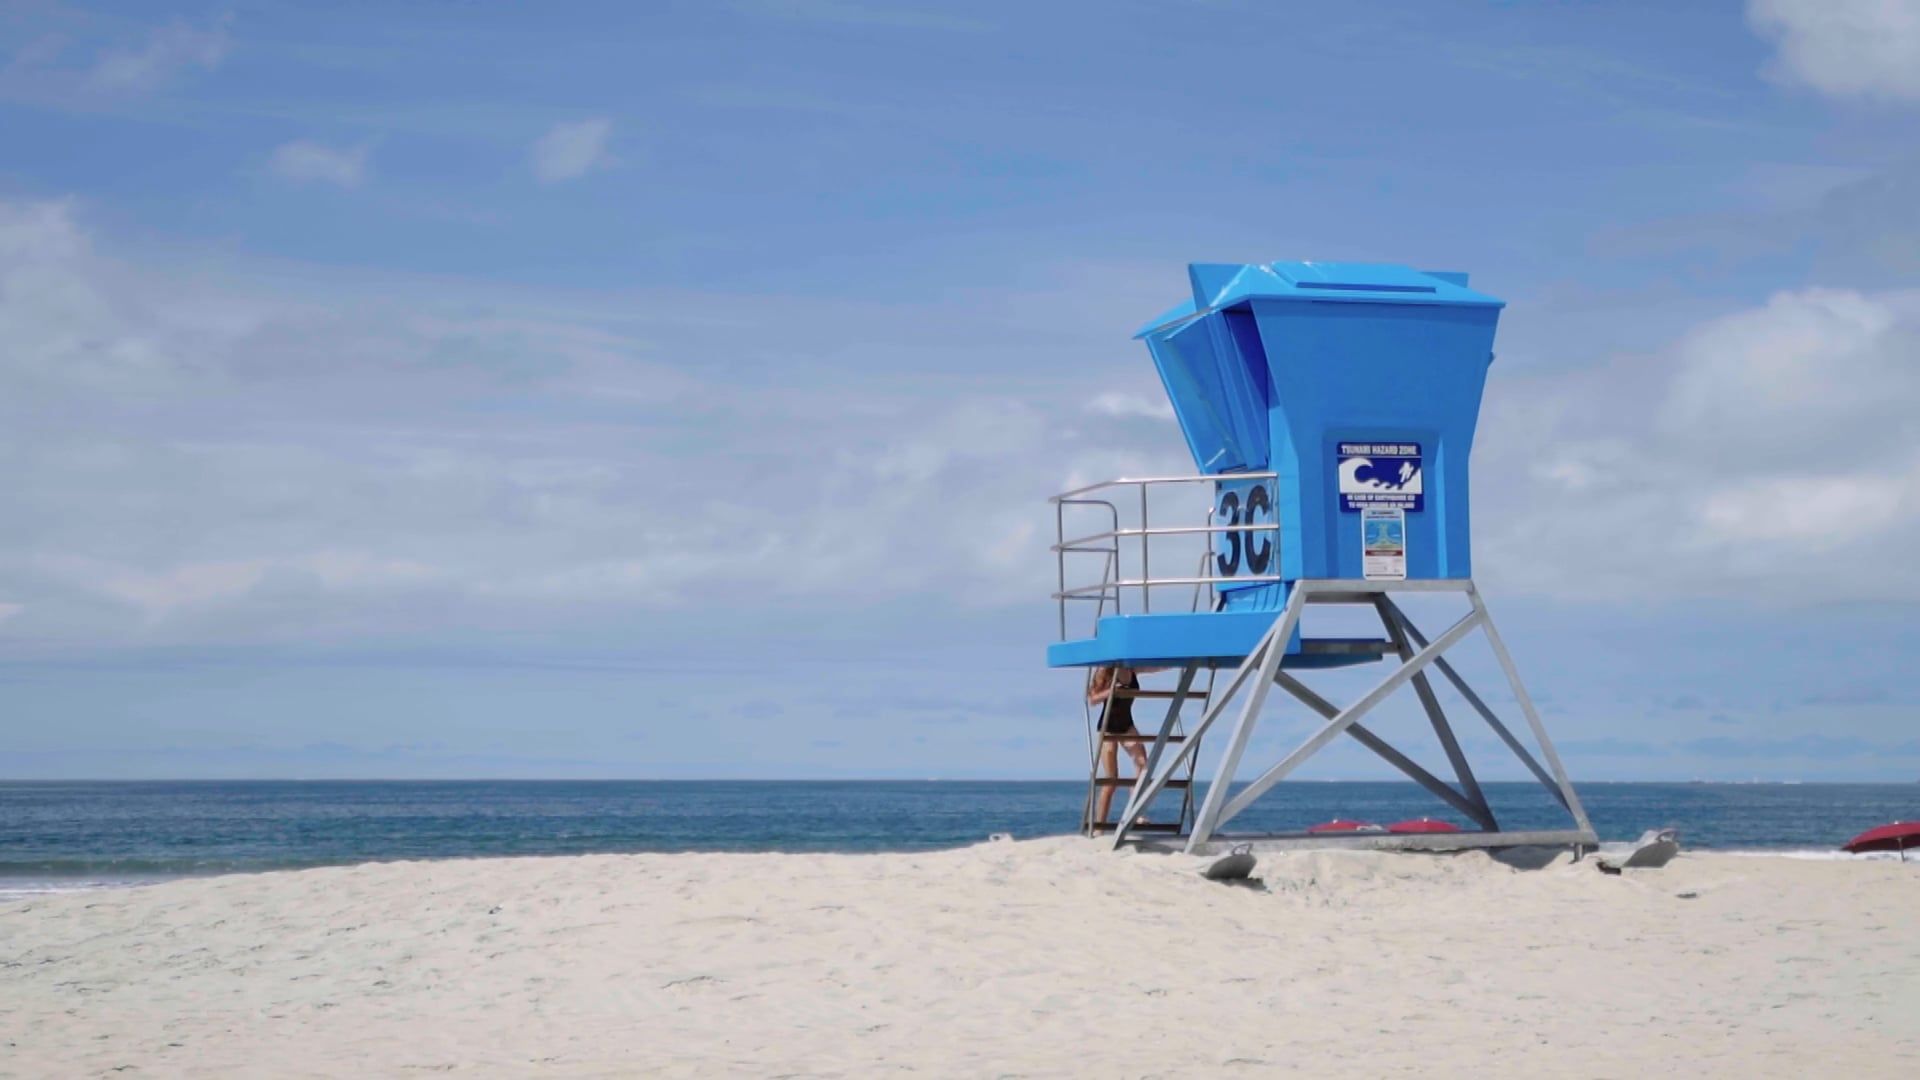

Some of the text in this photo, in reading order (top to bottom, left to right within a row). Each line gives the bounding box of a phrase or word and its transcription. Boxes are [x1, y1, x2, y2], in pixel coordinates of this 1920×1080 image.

[1341, 445, 1417, 455] TSUNAMI HAZARD ZONE
[1217, 485, 1271, 577] 3C
